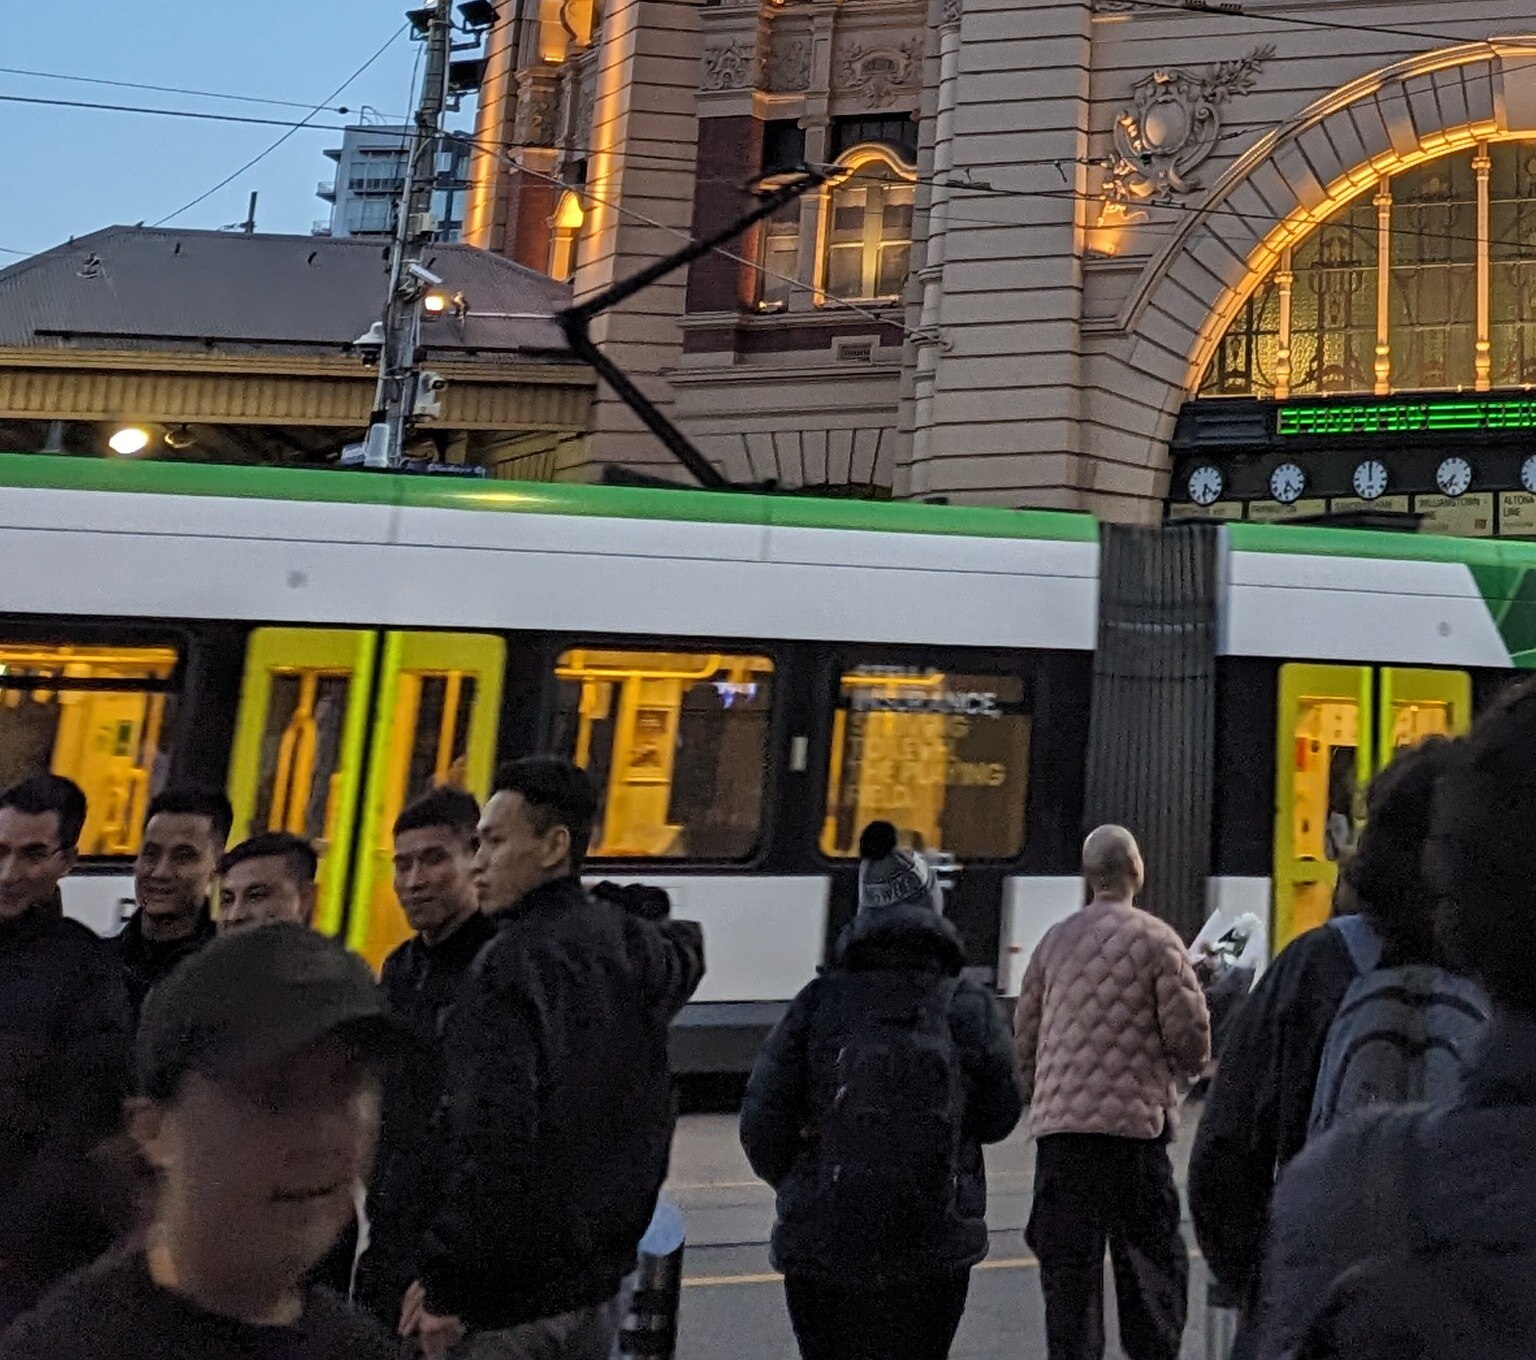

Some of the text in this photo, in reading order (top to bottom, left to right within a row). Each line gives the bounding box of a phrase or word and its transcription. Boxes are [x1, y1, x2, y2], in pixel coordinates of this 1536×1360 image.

[1277, 404, 1428, 434] FLINDERS
[1504, 495, 1534, 505] ALTONA
[1504, 507, 1521, 517] LINE
